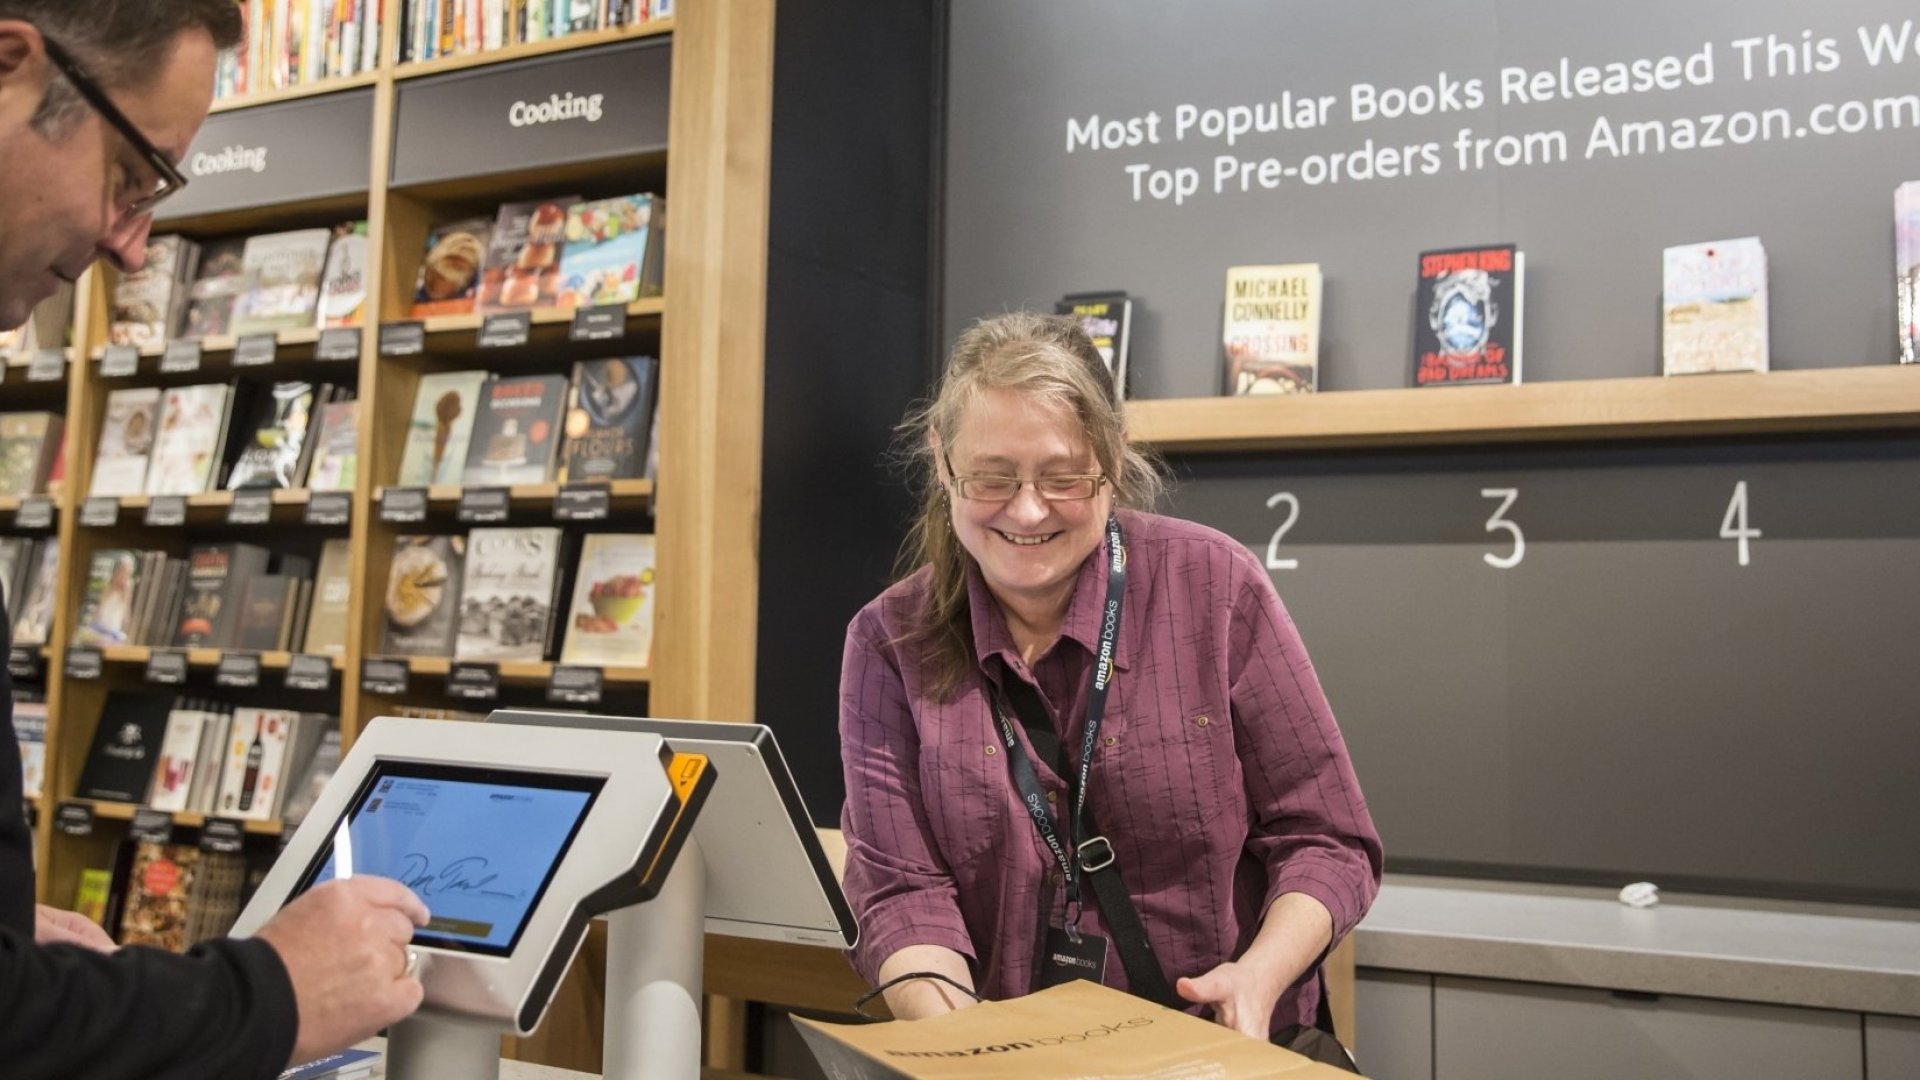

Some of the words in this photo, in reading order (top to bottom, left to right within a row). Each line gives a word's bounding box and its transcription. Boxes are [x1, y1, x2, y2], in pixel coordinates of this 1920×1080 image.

[510, 91, 604, 128] Cooking
[1066, 114, 1162, 153] Most
[1175, 90, 1337, 147] Popular
[1350, 71, 1485, 122] Books
[1500, 42, 1714, 105] Released
[1731, 28, 1841, 81] This
[1857, 19, 1920, 66] W
[191, 144, 268, 177] Cooking
[1125, 163, 1200, 205] Top
[1214, 138, 1441, 194] Pre-orders
[1453, 128, 1567, 172] from
[1584, 94, 1920, 160] Amazon.com
[1232, 302, 1308, 321] CONNELLY
[1234, 277, 1309, 298] MICHAEL
[1110, 531, 1123, 573] amazon
[1265, 491, 1300, 570] 2
[1481, 488, 1526, 569] 3
[1719, 480, 1763, 567] 4
